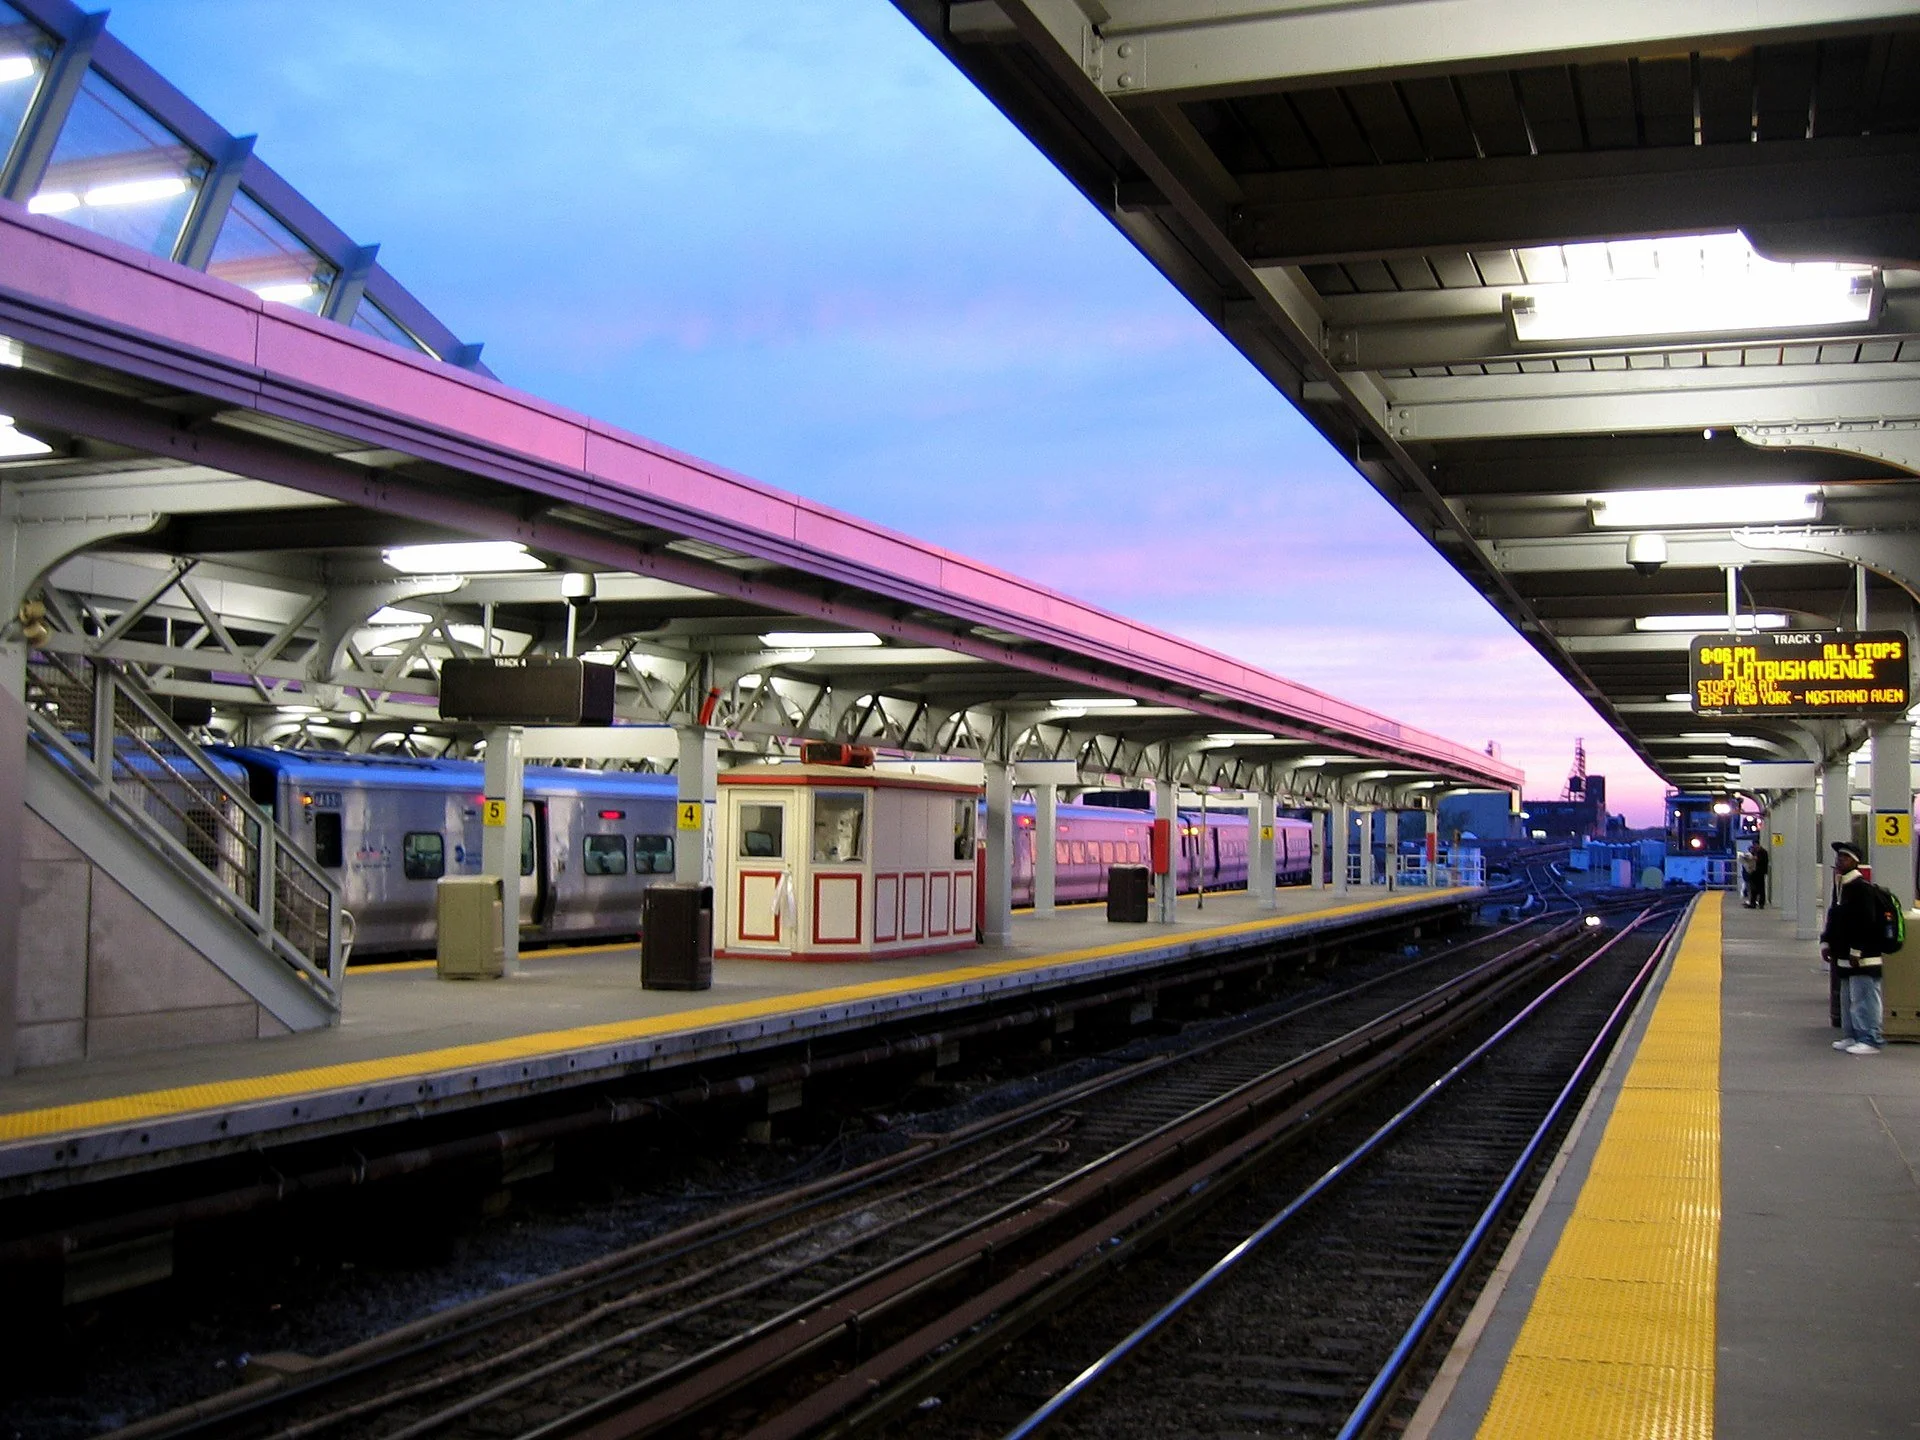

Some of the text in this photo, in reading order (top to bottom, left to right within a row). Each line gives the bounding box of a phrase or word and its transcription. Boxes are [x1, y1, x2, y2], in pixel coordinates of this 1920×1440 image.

[1773, 633, 1822, 644] TRACK 3
[1734, 647, 1756, 663] PM
[1823, 643, 1851, 659] ALL
[1854, 642, 1902, 659] STOPS
[494, 658, 519, 667] TRACK
[1723, 659, 1875, 680] FLATBUSH AVENUE
[1697, 678, 1757, 693] STOPPING
[1700, 692, 1731, 706] EAST
[1734, 691, 1757, 706] NEW
[1760, 690, 1792, 705] YORK
[1805, 688, 1868, 705] NOSTRAND
[1870, 688, 1904, 703] AVEN
[490, 801, 500, 818] 5
[684, 804, 695, 822] 4
[1885, 815, 1900, 837] 3
